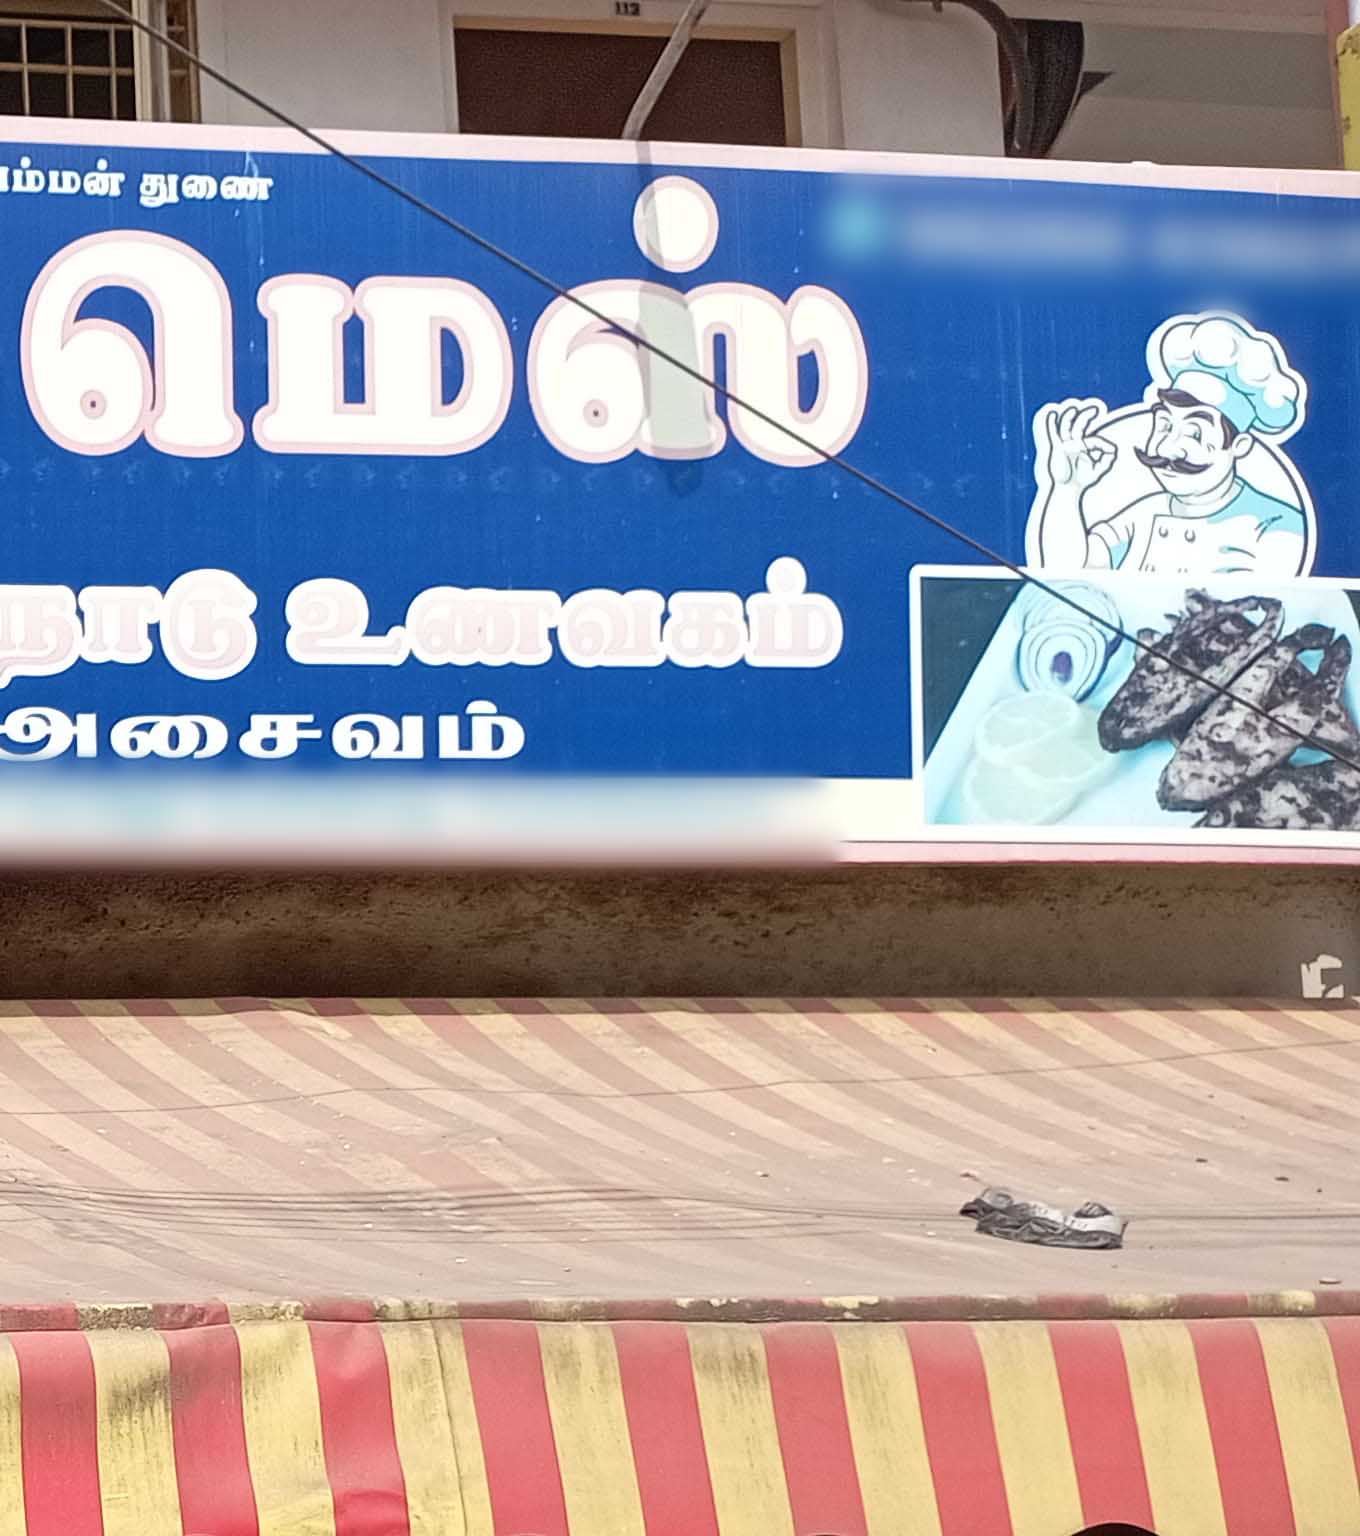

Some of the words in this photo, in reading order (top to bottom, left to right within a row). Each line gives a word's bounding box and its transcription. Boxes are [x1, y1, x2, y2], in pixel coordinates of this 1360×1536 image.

[139, 168, 274, 209] துணை
[19, 174, 869, 468] மெஸ்
[284, 557, 843, 667] உணவகம்
